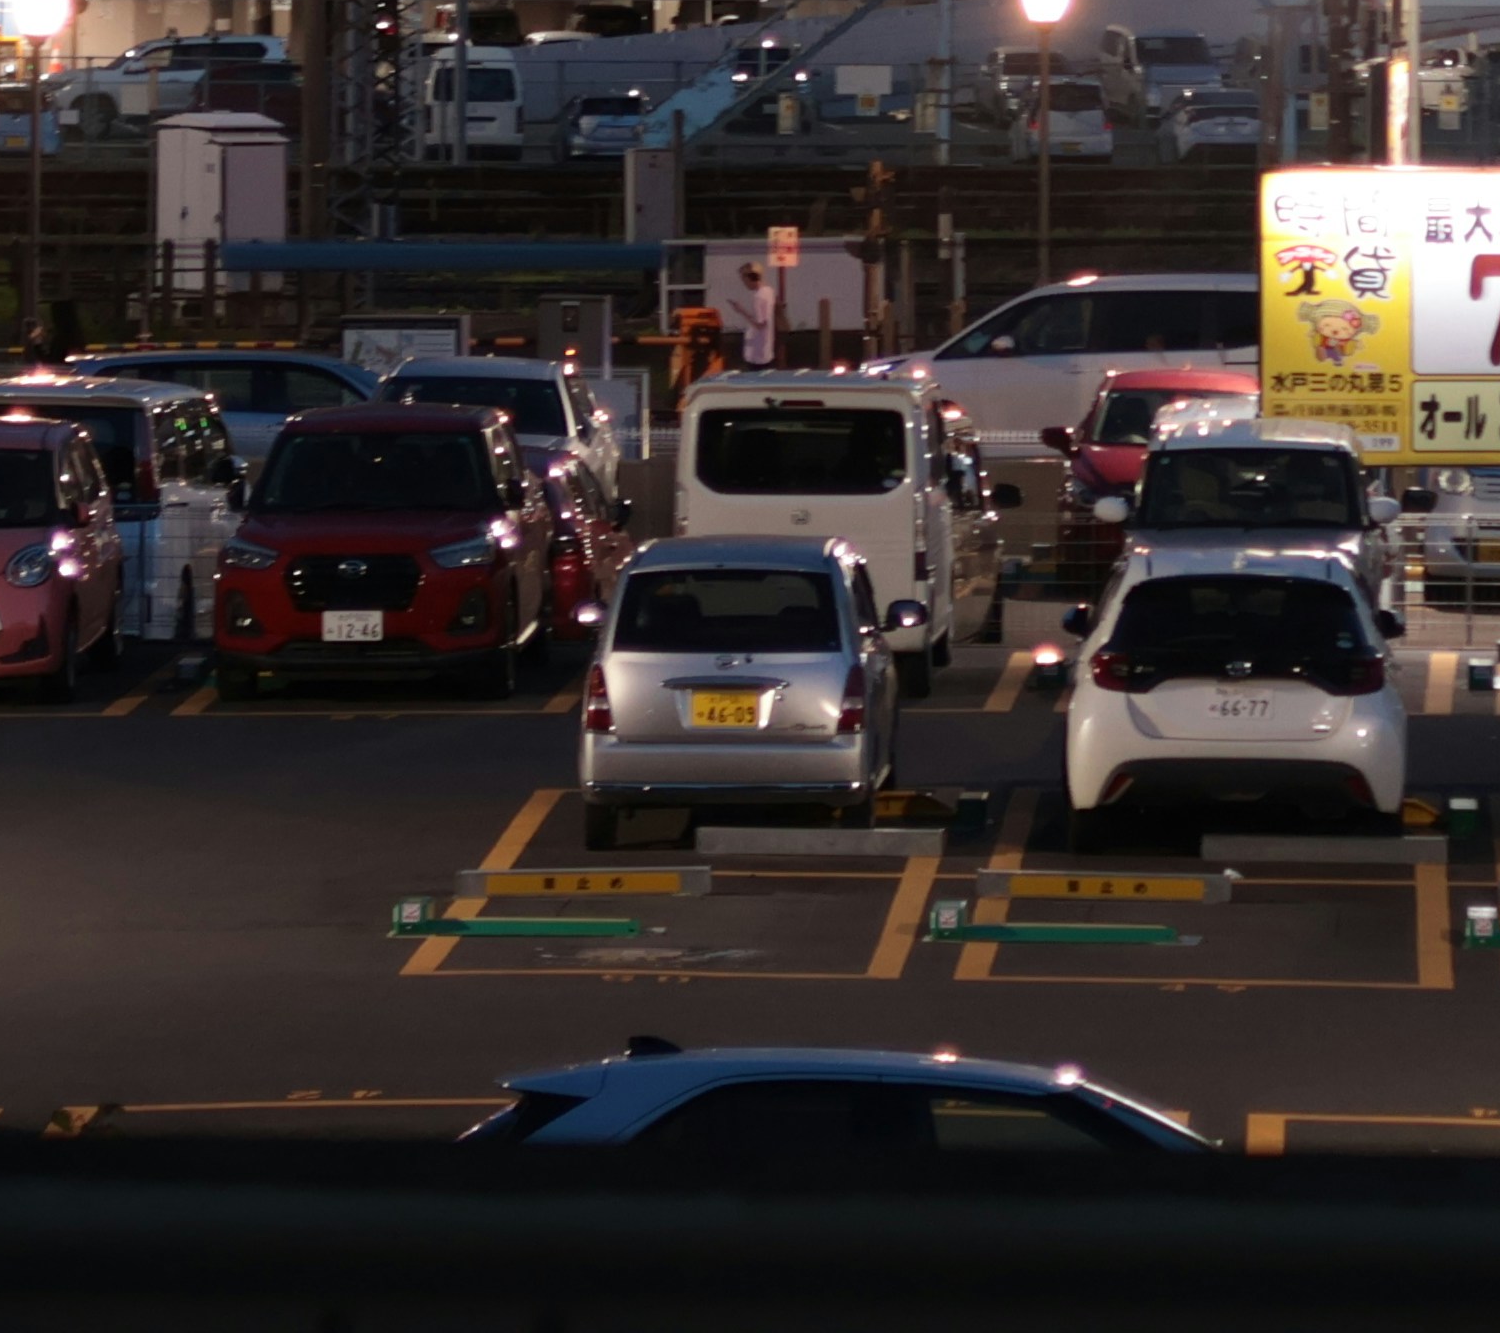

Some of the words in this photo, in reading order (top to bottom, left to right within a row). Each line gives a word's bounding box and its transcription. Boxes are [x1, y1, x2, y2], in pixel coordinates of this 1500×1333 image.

[1418, 394, 1486, 441] オール
[1219, 700, 1269, 717] 66-77
